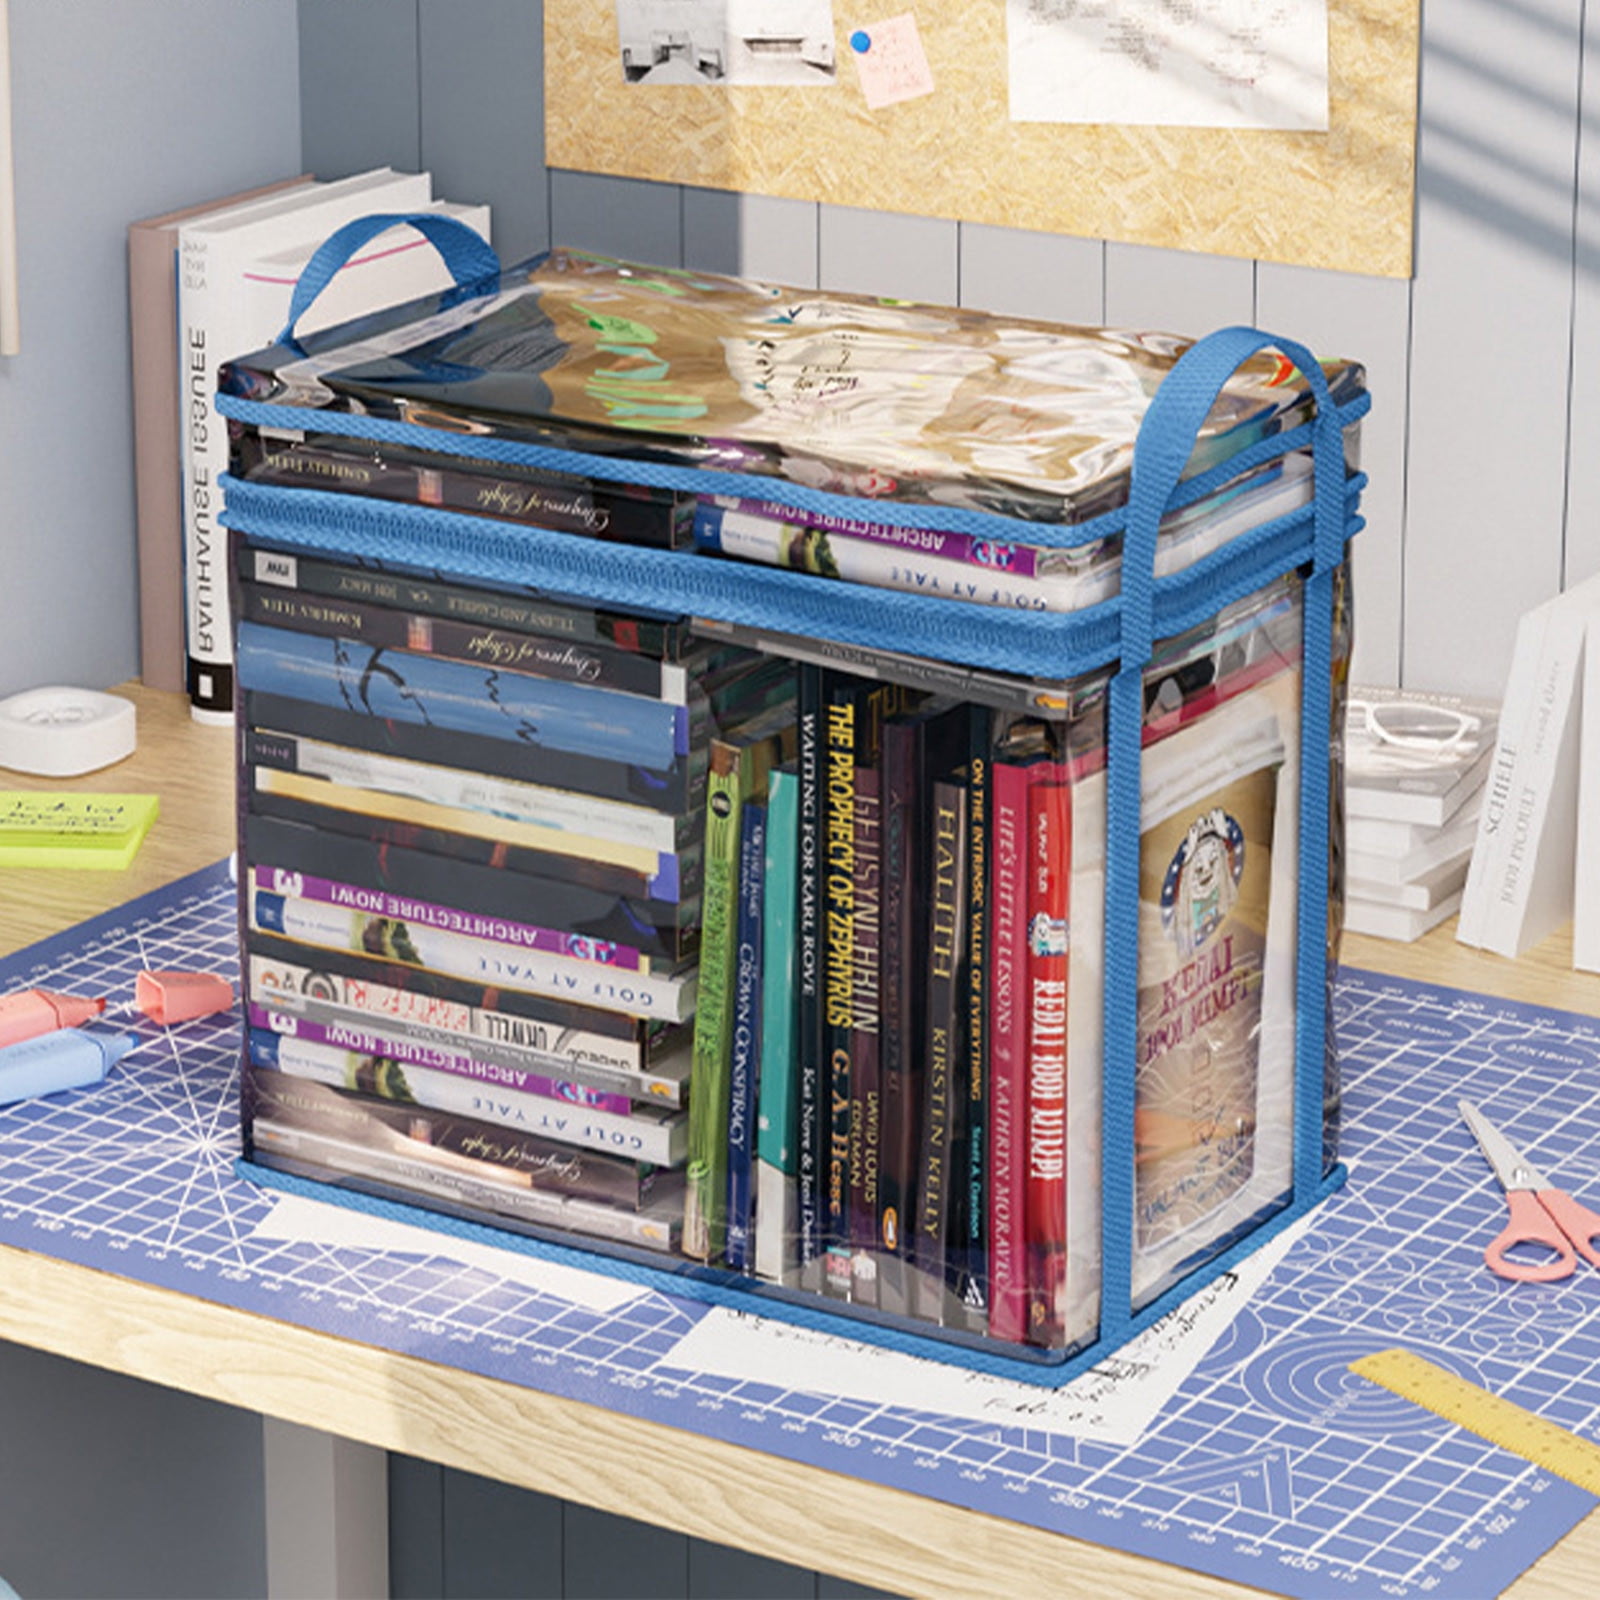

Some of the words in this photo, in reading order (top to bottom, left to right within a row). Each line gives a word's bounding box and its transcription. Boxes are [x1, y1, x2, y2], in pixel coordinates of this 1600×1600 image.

[829, 703, 854, 748] THE
[802, 713, 815, 817] WAITING
[972, 758, 984, 785] ON
[829, 751, 854, 873] PROPHECY
[972, 789, 984, 822] THE
[802, 823, 815, 869] FOR
[1000, 806, 1017, 866] LIFE'S
[828, 875, 853, 908] OF
[972, 826, 984, 908] INTRINSIC
[331, 887, 384, 912] NOW!
[388, 892, 537, 945] ARCHITECTURE
[802, 873, 815, 936] KARL
[999, 868, 1014, 943] LITTLE
[971, 911, 983, 964] VALUE
[478, 955, 536, 982] YALE
[550, 971, 578, 990] AT
[737, 943, 754, 1025] CROWN
[802, 937, 815, 996] ROVE
[827, 911, 853, 1028] ZEPHYRUS
[970, 969, 982, 992] OF
[997, 944, 1013, 1034] LESSONS
[593, 981, 654, 1008] GOLF
[325, 1025, 378, 1056] NOW!
[382, 1038, 528, 1086] ARCHITECTURE
[832, 1048, 849, 1081] G.
[971, 995, 982, 1101] EVERYTHING
[472, 1096, 527, 1123] YALE
[730, 1026, 750, 1152] CONSPIRACY
[832, 1090, 849, 1122] A.
[931, 1027, 947, 1147] KIRSTEN
[541, 1113, 568, 1133] AT
[582, 1121, 644, 1150] GOLF
[867, 1091, 879, 1146] DAVID
[996, 1075, 1012, 1178] KATHRYN
[802, 1153, 813, 1171] &
[830, 1132, 849, 1217] Hesse
[865, 1149, 878, 1203] LOUIS
[924, 1156, 941, 1240] KELLY
[822, 1429, 862, 1450] 300
[1278, 1553, 1320, 1573] 400
